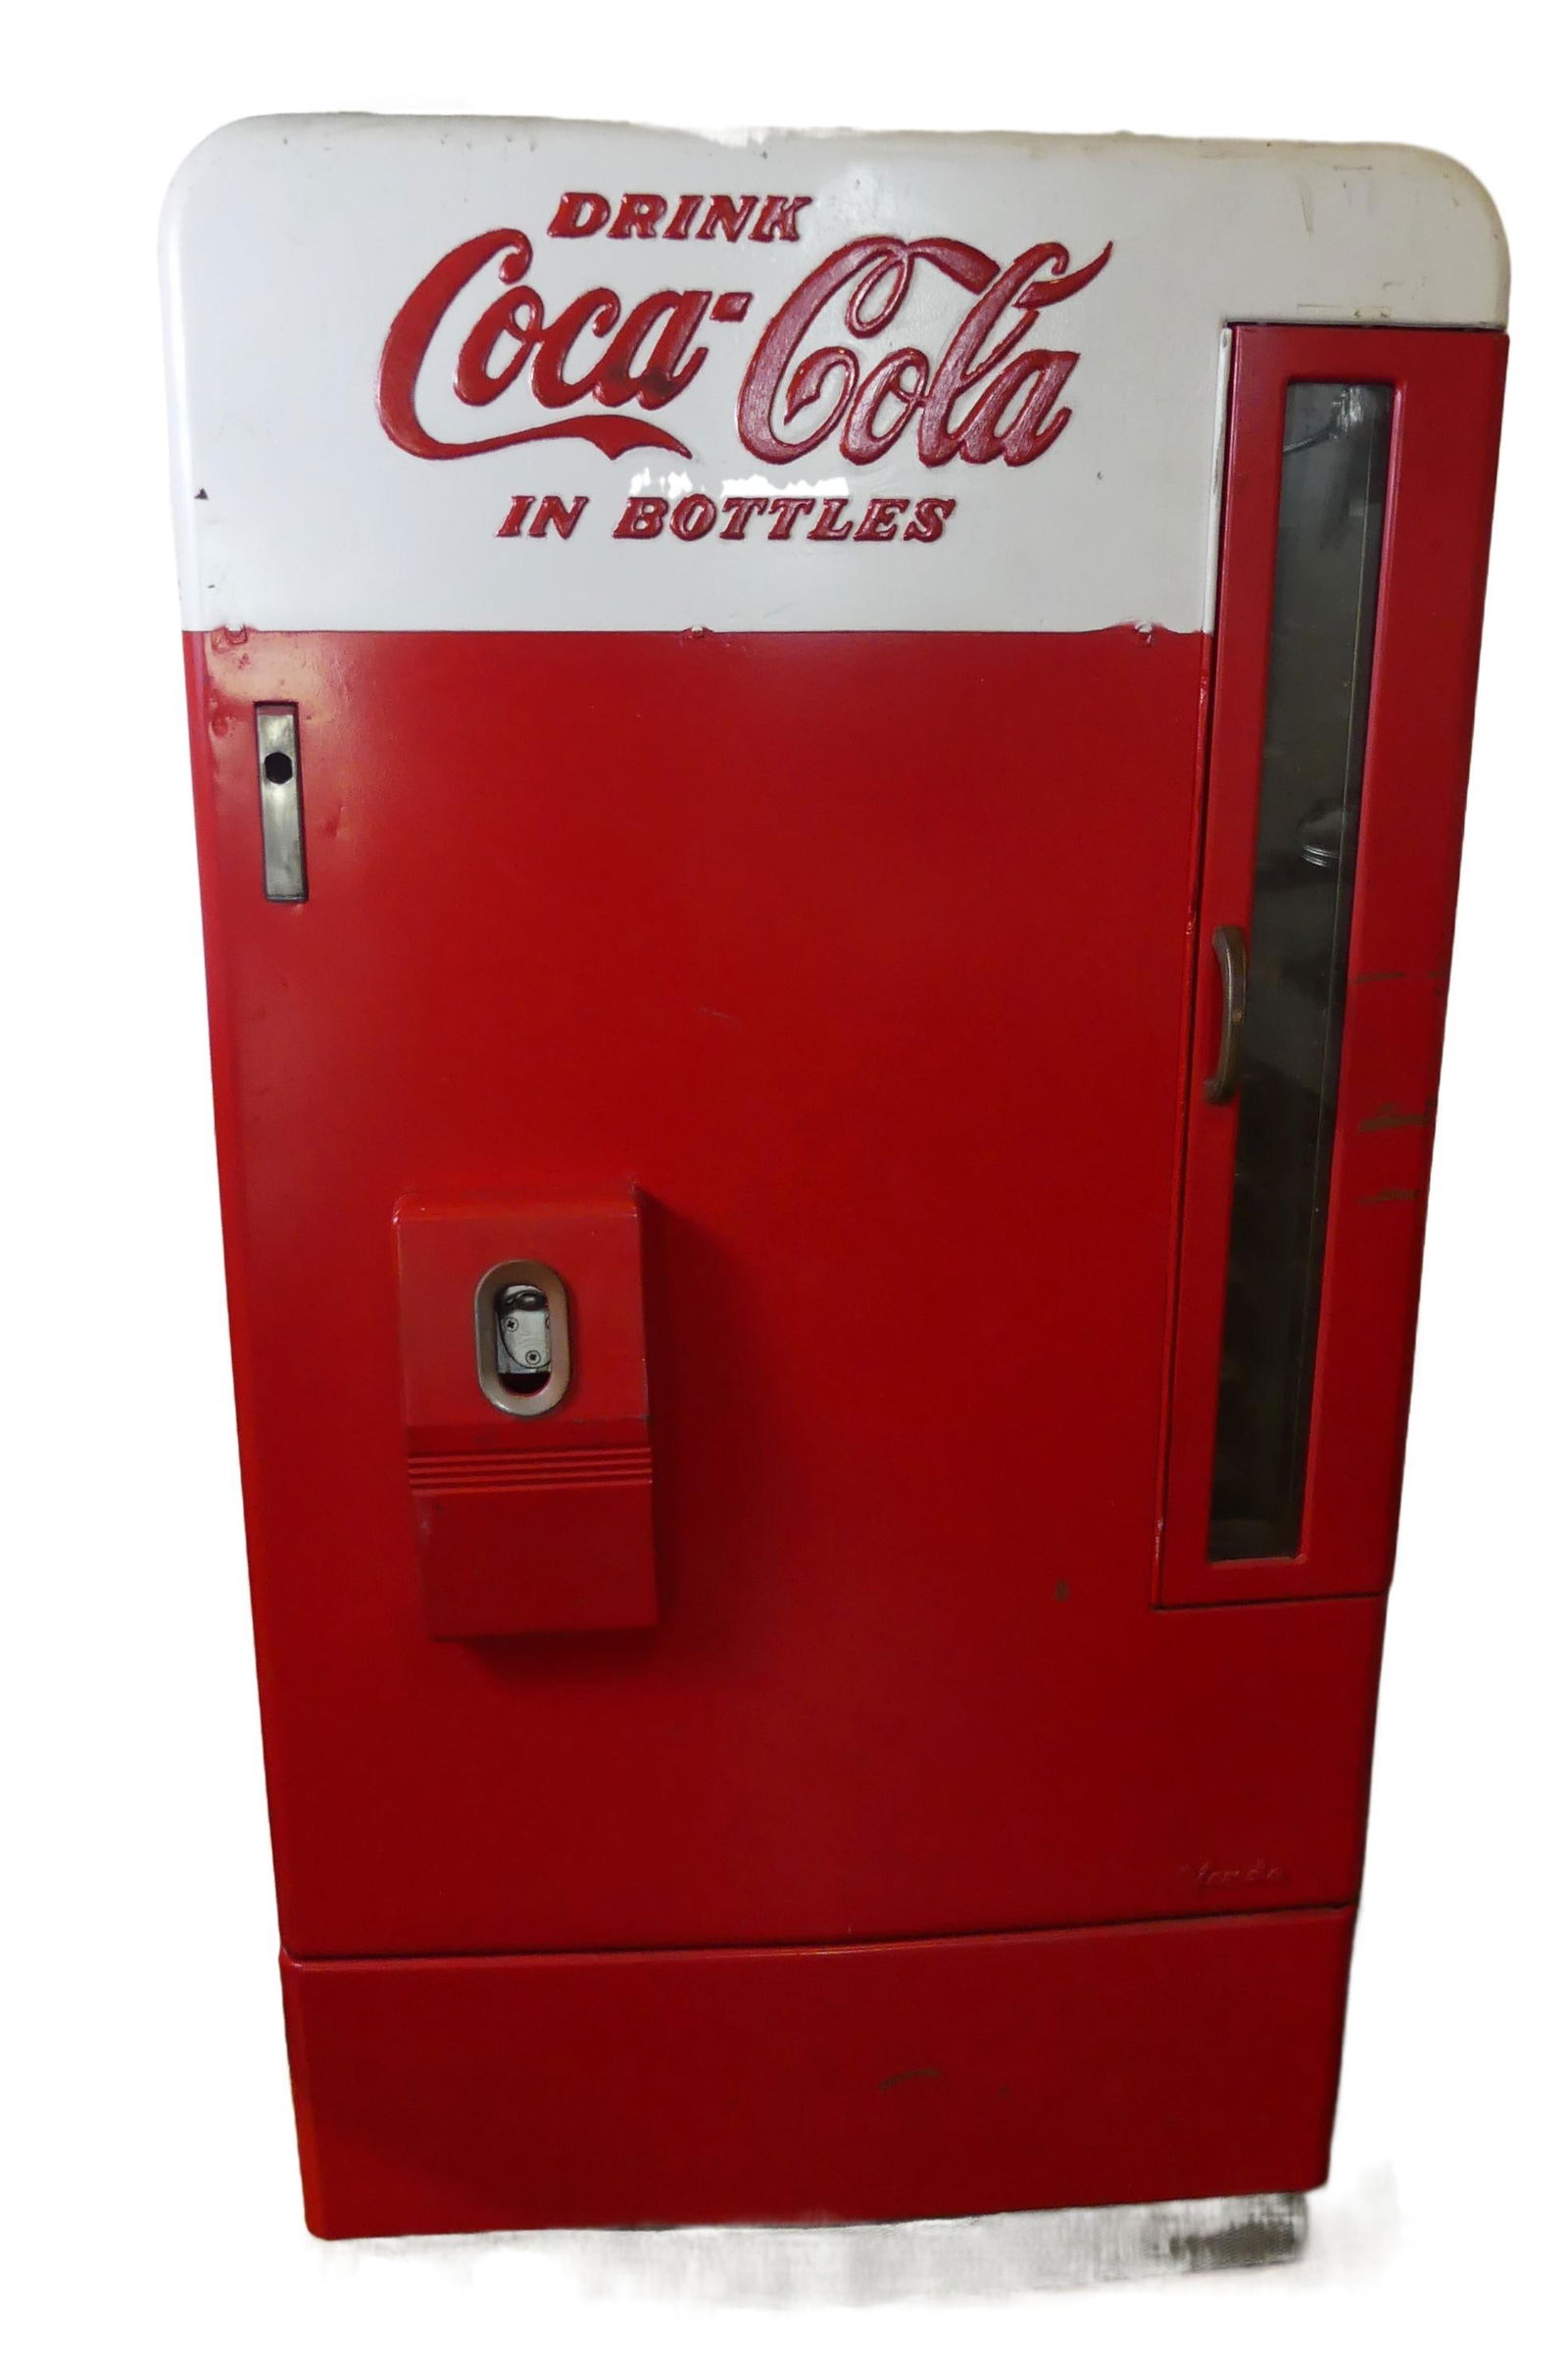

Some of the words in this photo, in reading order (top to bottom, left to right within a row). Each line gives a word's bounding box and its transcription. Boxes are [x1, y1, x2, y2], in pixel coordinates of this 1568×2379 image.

[547, 191, 812, 243] DRINK
[495, 494, 589, 539] IN
[612, 494, 957, 542] BOTTLES
